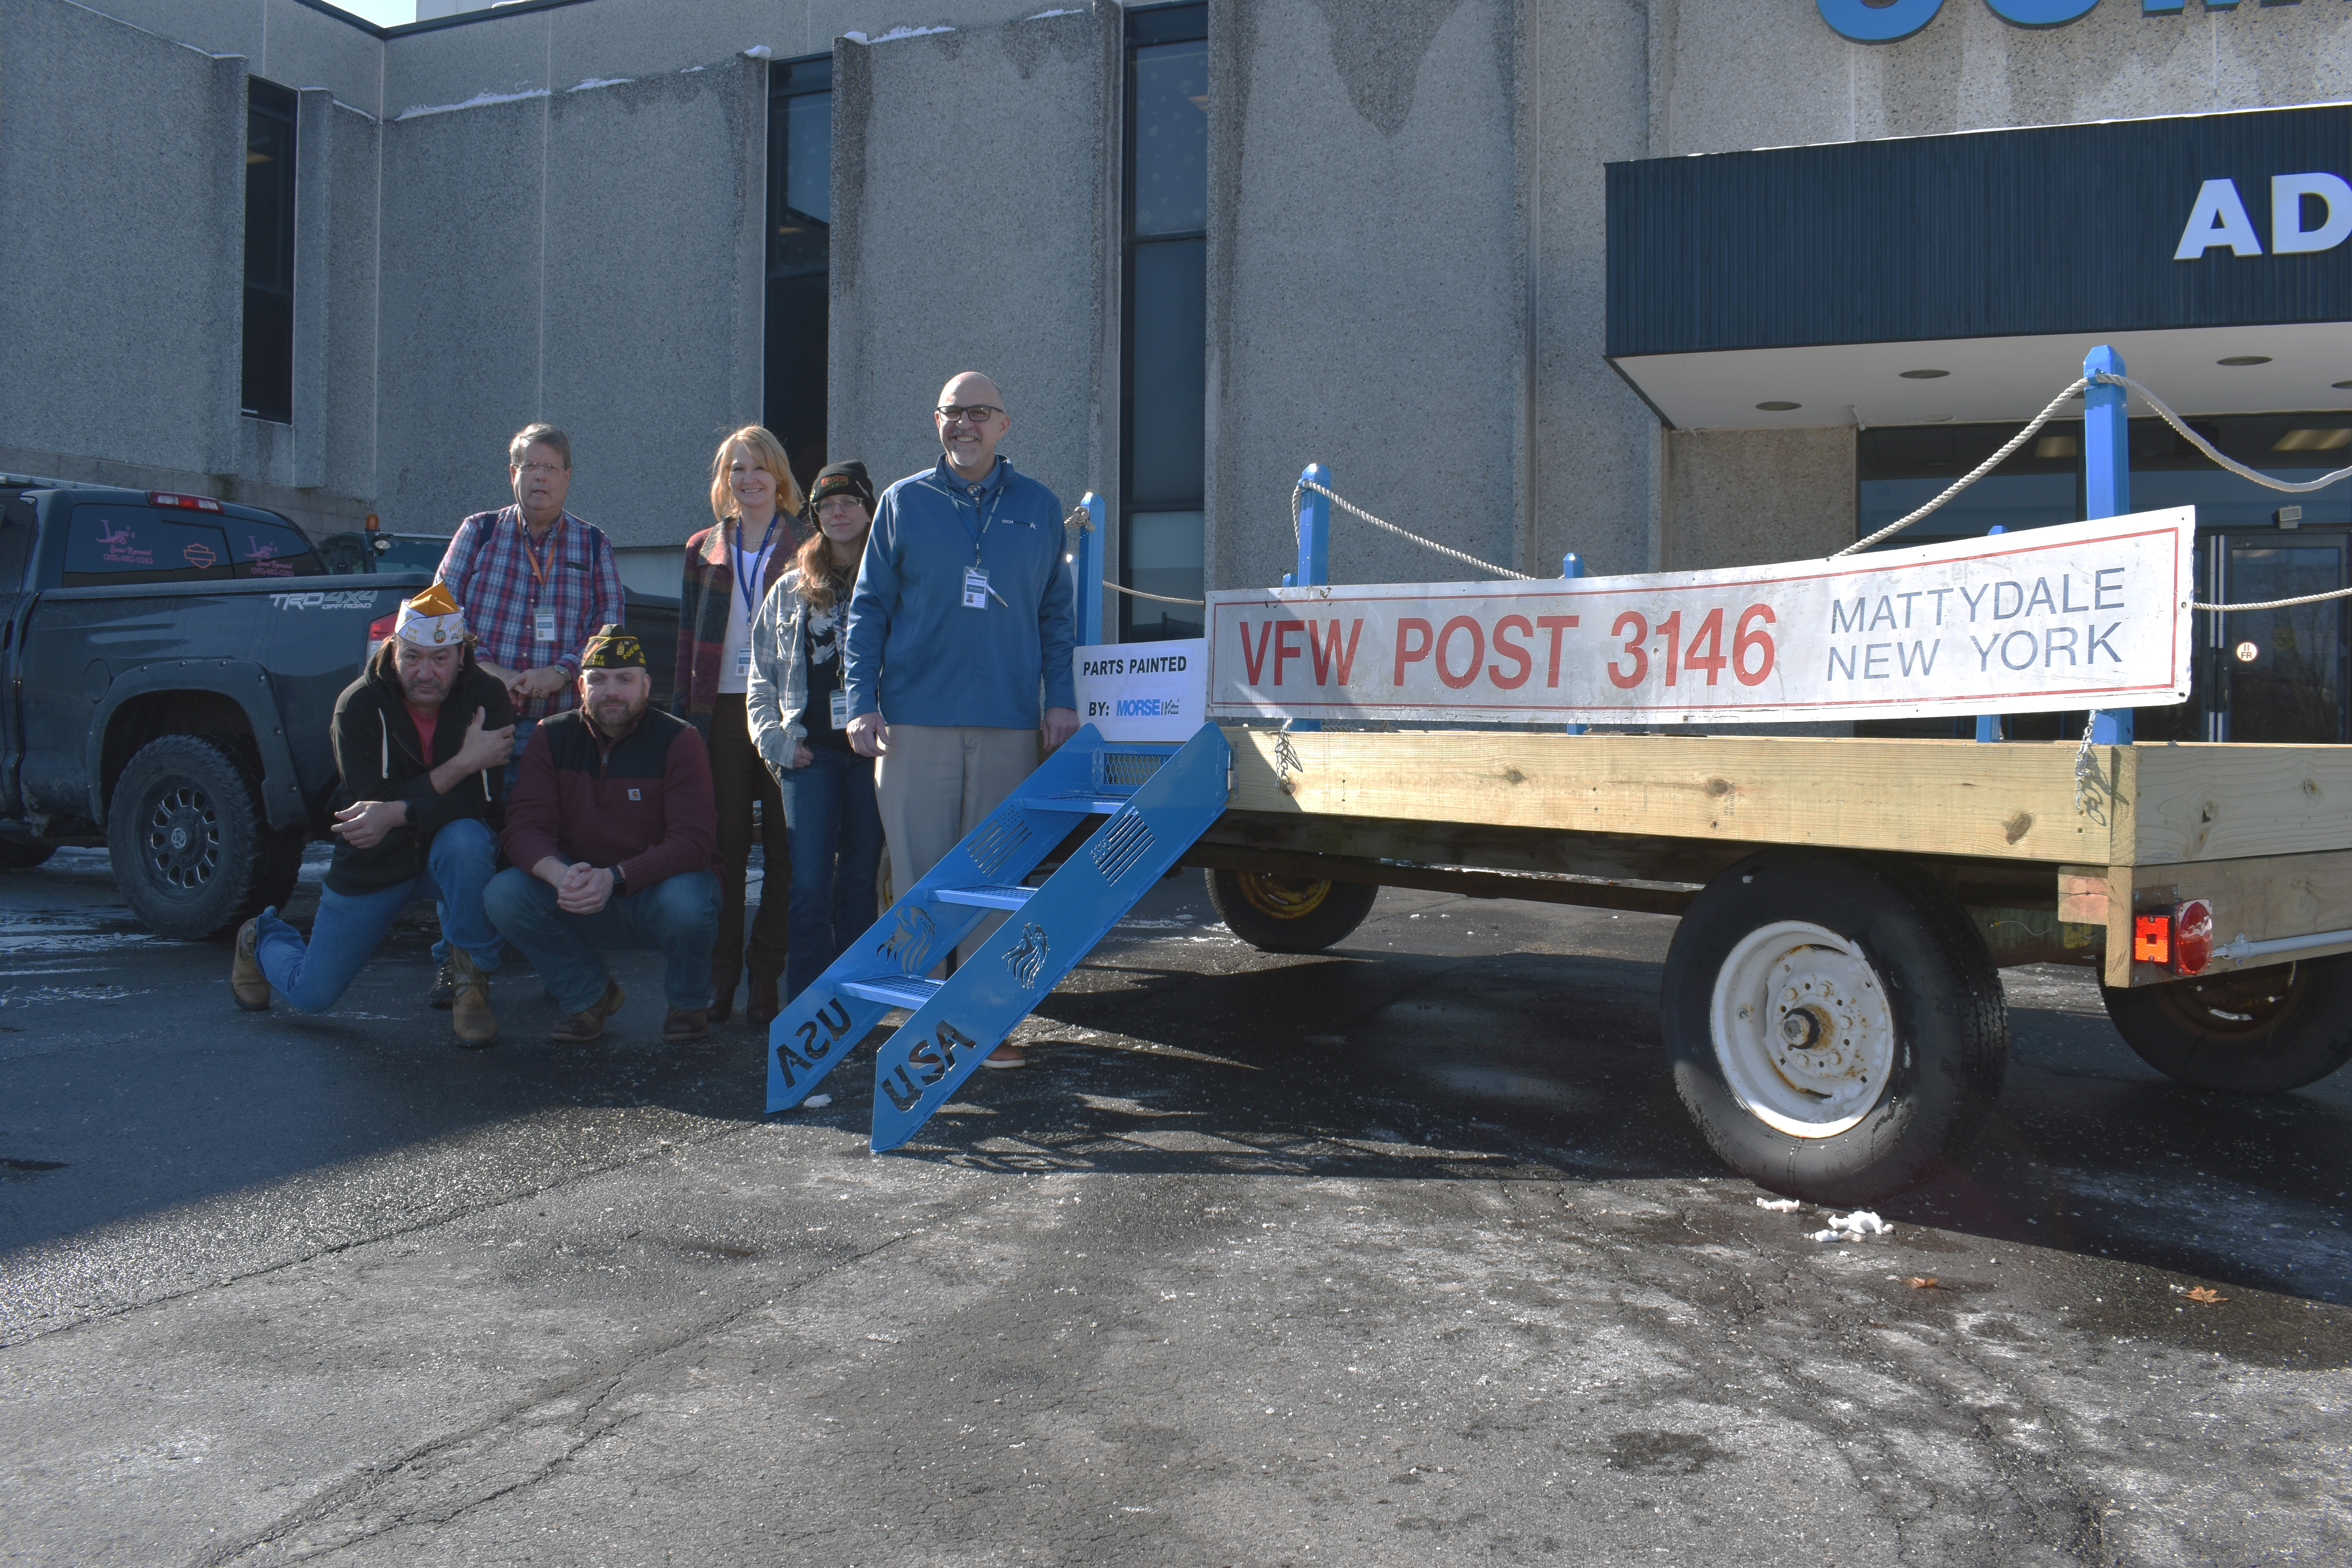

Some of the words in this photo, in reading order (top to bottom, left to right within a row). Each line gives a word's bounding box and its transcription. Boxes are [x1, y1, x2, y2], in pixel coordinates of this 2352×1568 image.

[2173, 172, 2352, 260] AD
[269, 592, 325, 610] TRD
[324, 590, 379, 604] 4X4
[1831, 567, 2125, 634] MATTYDALE
[405, 632, 417, 641] 3146
[407, 626, 419, 635] VFW
[449, 621, 459, 633] POST
[1240, 618, 1364, 686] VFW
[1394, 614, 1580, 690] POST
[1607, 603, 1777, 689] 3146
[1083, 659, 1124, 676] PARTS
[1129, 656, 1187, 674] PAINTED
[1827, 639, 1941, 682] NEW
[1970, 621, 2123, 672] YORK
[1089, 701, 1110, 716] BY:
[1116, 699, 1160, 717] MORSE
[880, 1020, 977, 1112] USA
